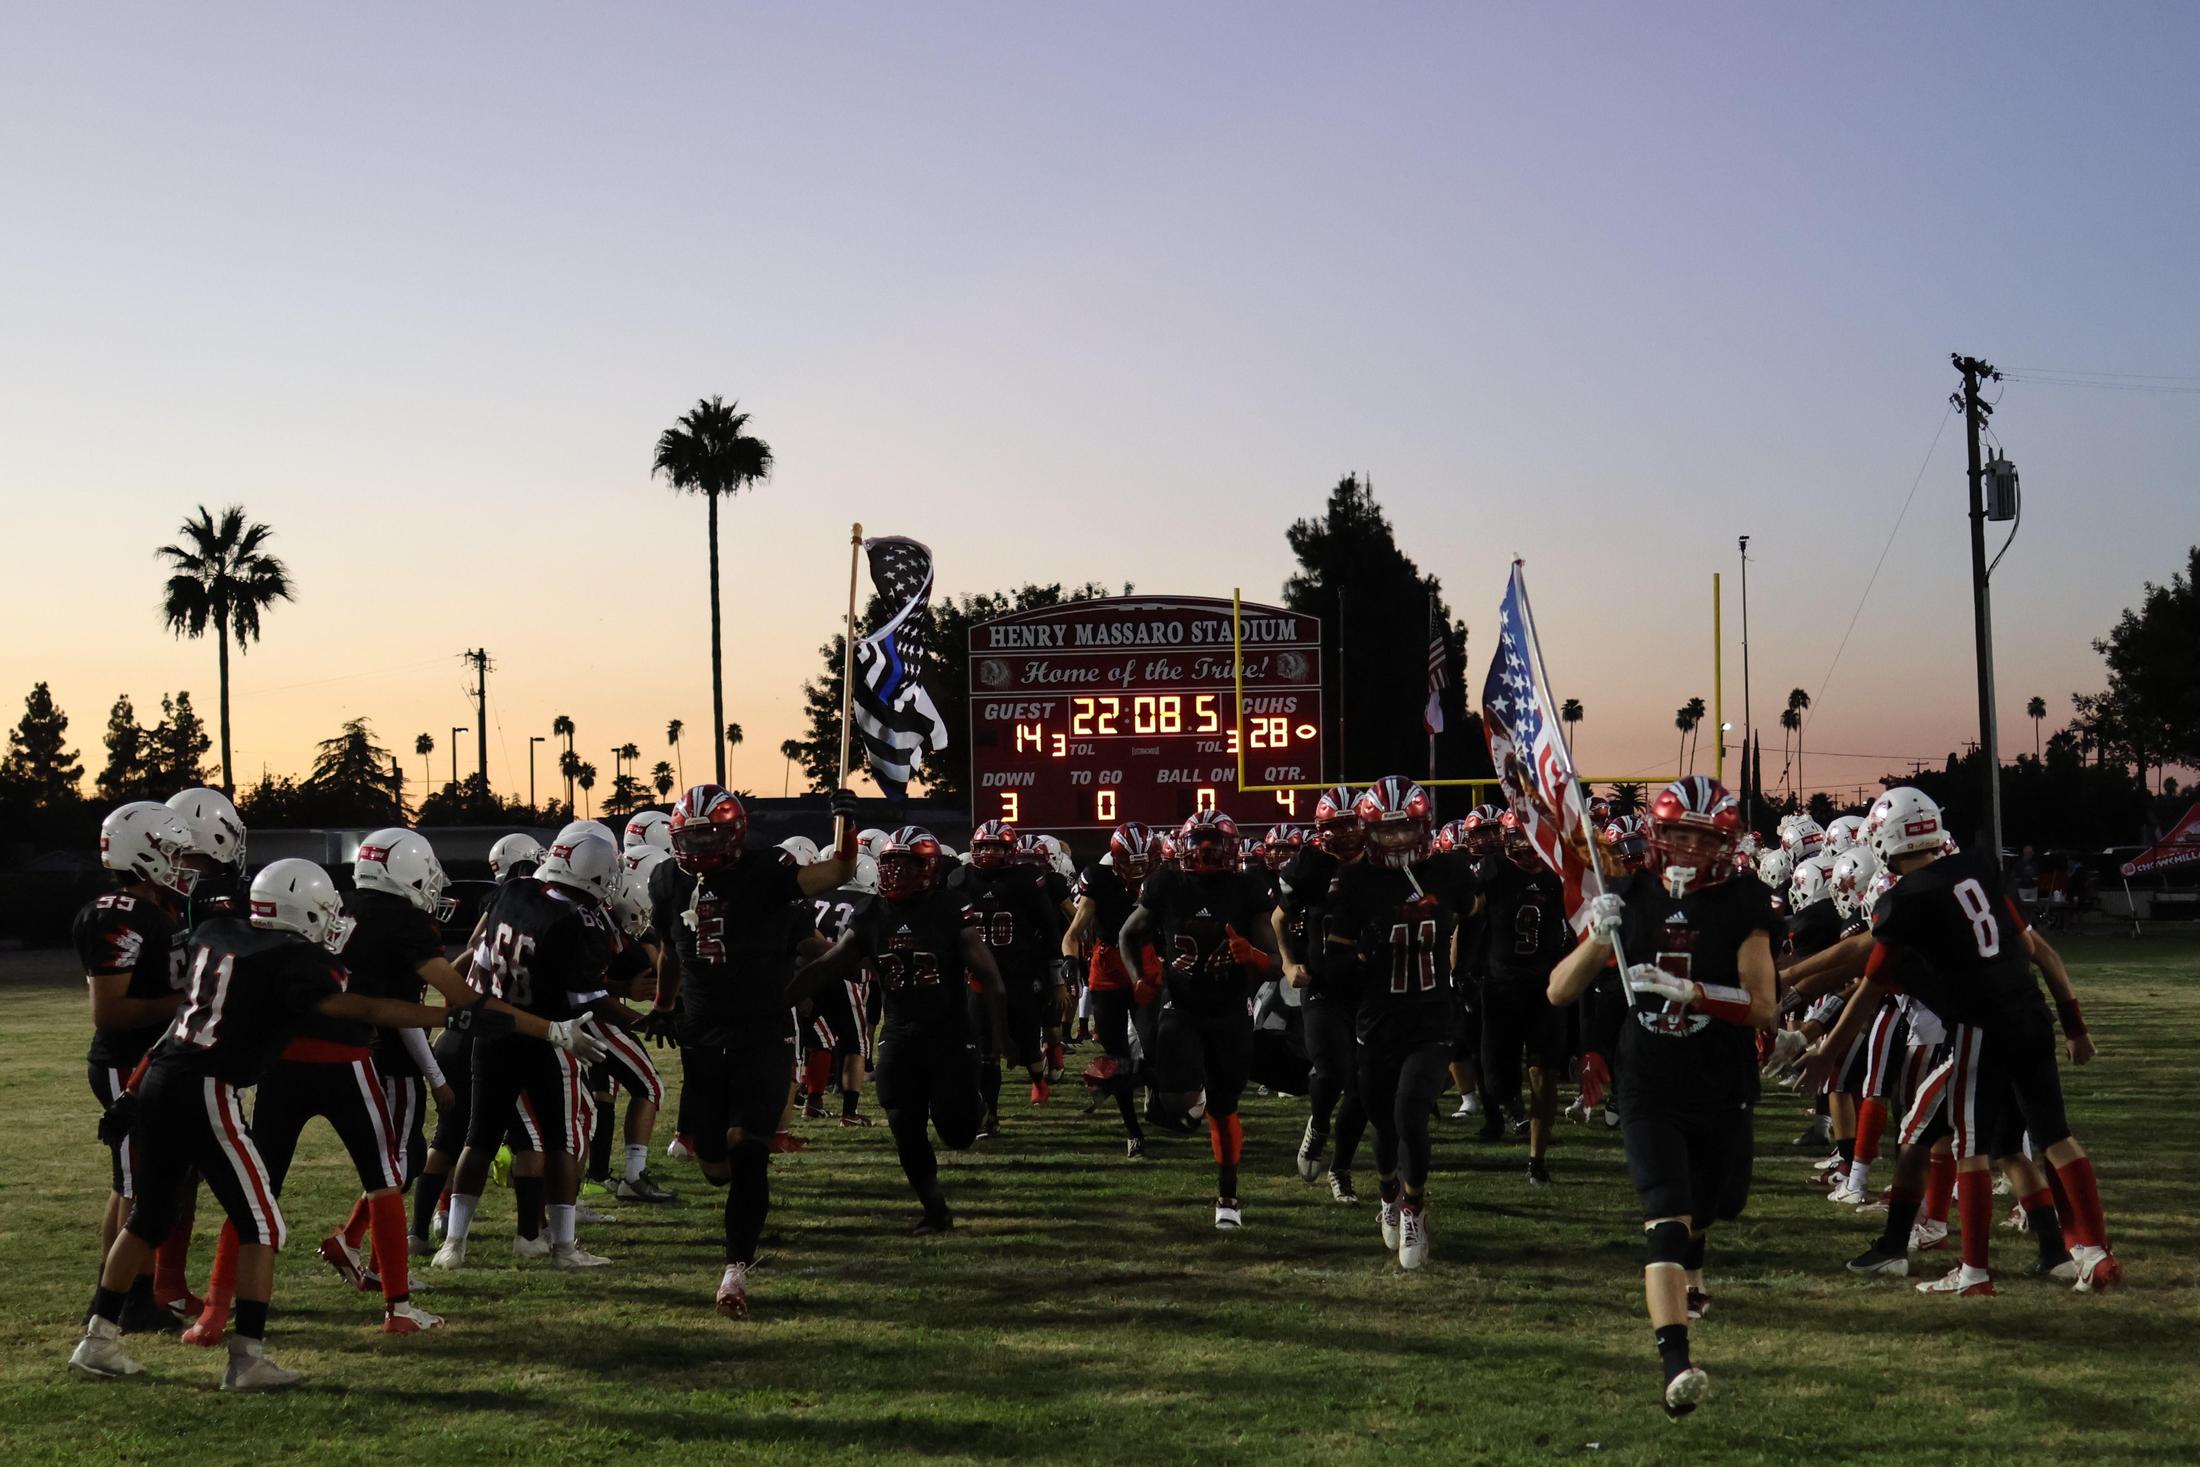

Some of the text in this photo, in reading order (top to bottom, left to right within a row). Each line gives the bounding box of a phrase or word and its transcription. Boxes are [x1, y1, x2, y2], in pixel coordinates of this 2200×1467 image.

[989, 618, 1297, 648] HENRY MASSARO STADIUM
[1020, 661, 1100, 684] Home
[1107, 658, 1137, 688] of
[1144, 657, 1184, 681] the
[985, 703, 1056, 720] GUEST
[1240, 697, 1298, 714] CUHS
[1016, 723, 1042, 753] 14
[1051, 733, 1067, 757] 3
[1196, 740, 1223, 753] TOL
[1225, 729, 1240, 753] 3
[1249, 717, 1288, 748] 28
[1069, 743, 1096, 756] TOL
[981, 772, 1036, 787] DOWN
[1070, 770, 1124, 785] TO GO
[1156, 767, 1236, 783] BALL ON
[1264, 766, 1306, 781] QTR.
[1000, 792, 1018, 822] 3
[1096, 790, 1116, 821] 0
[1276, 789, 1295, 817] 4
[1514, 905, 1541, 955] 9
[1953, 878, 2000, 958] 8
[696, 917, 727, 965] 5
[490, 922, 537, 1007] 66
[1389, 920, 1437, 993] 11
[174, 946, 236, 1048] 11
